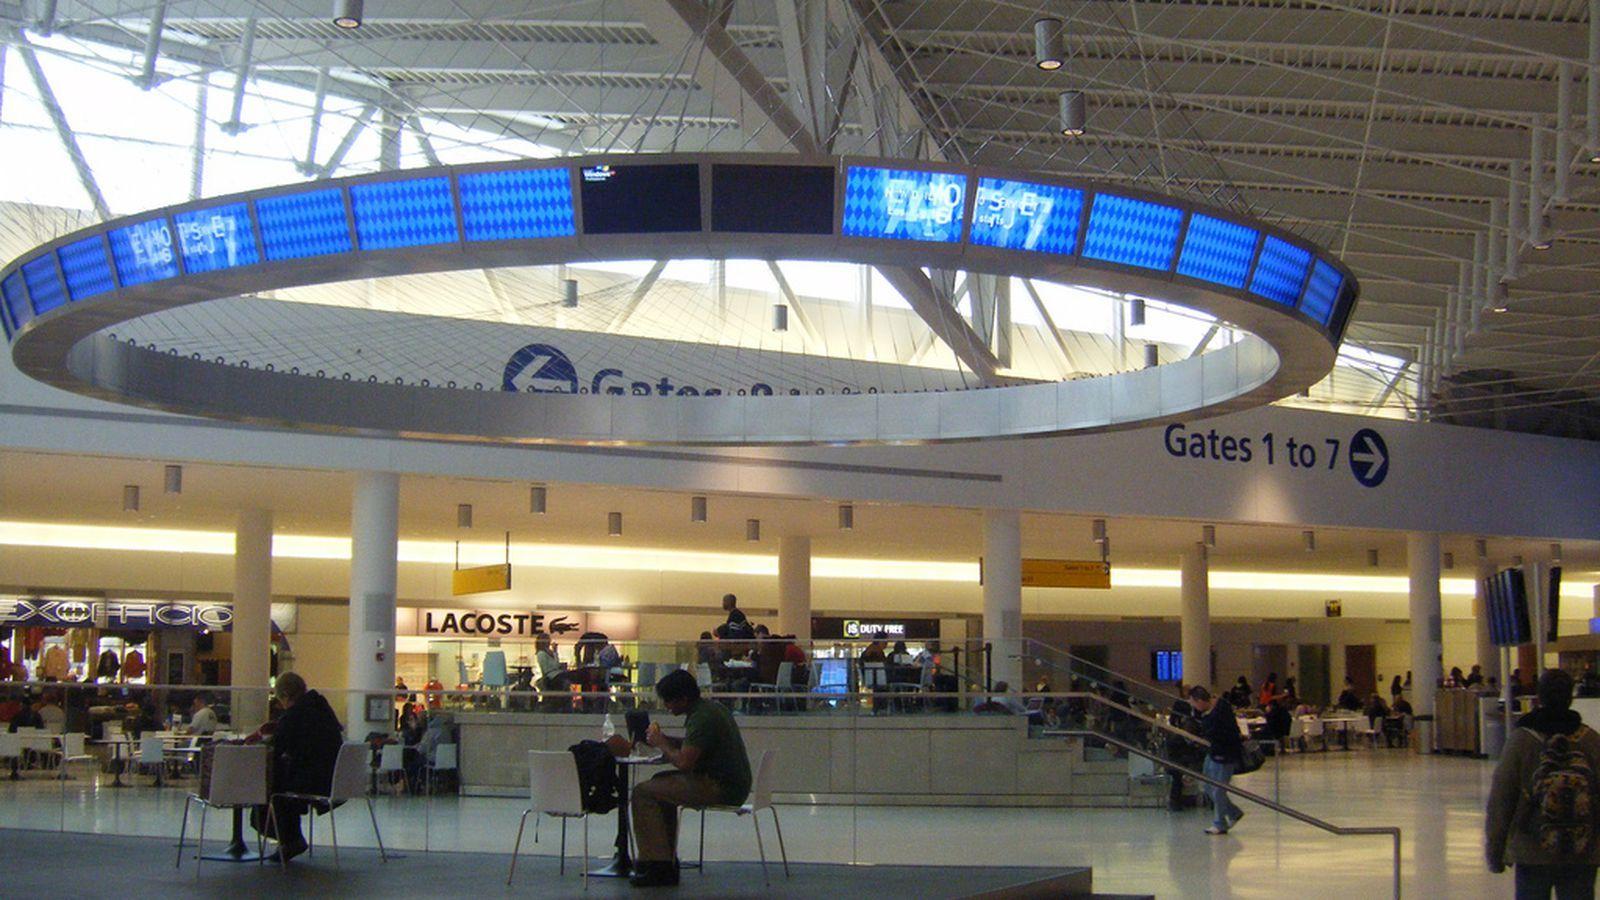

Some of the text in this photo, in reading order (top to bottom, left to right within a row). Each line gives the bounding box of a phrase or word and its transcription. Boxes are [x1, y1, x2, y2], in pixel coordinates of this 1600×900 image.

[591, 368, 723, 397] Gat
[1164, 422, 1340, 470] Gates 1 to 7
[426, 612, 545, 635] LACOSTE
[860, 624, 883, 634] DUTY
[884, 624, 904, 634] FREE
